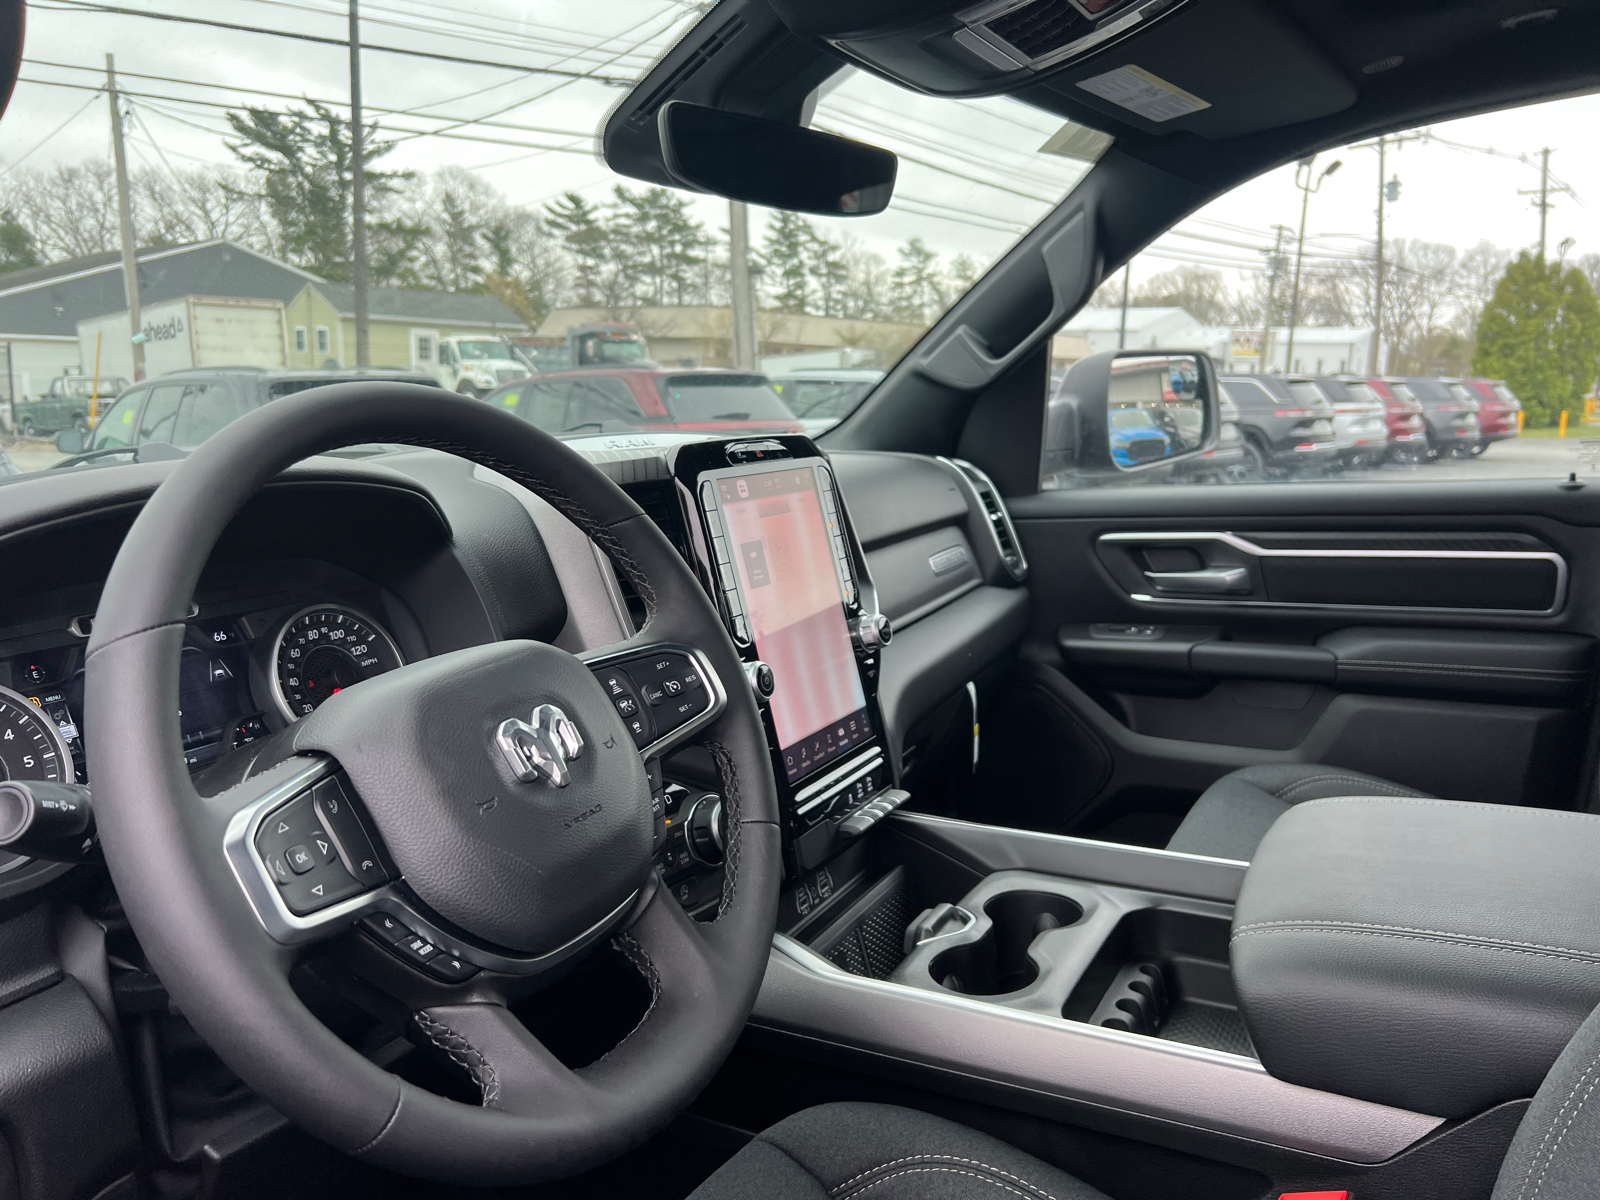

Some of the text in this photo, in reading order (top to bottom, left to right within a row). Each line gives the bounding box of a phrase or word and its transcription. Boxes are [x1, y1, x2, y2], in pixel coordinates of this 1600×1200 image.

[603, 438, 656, 449] RAM
[308, 629, 319, 640] 80
[320, 626, 328, 634] 90
[329, 629, 345, 641] 100
[214, 631, 227, 642] 66
[298, 637, 306, 645] 70
[290, 648, 301, 658] 60
[350, 644, 368, 656] 120
[361, 657, 378, 667] MPH
[32, 671, 39, 679] E
[685, 674, 697, 683] RES
[289, 677, 299, 687] 40
[302, 703, 314, 713] 20
[3, 729, 15, 741] 4
[23, 755, 34, 768] 5
[663, 794, 673, 804] D
[295, 852, 308, 864] OK
